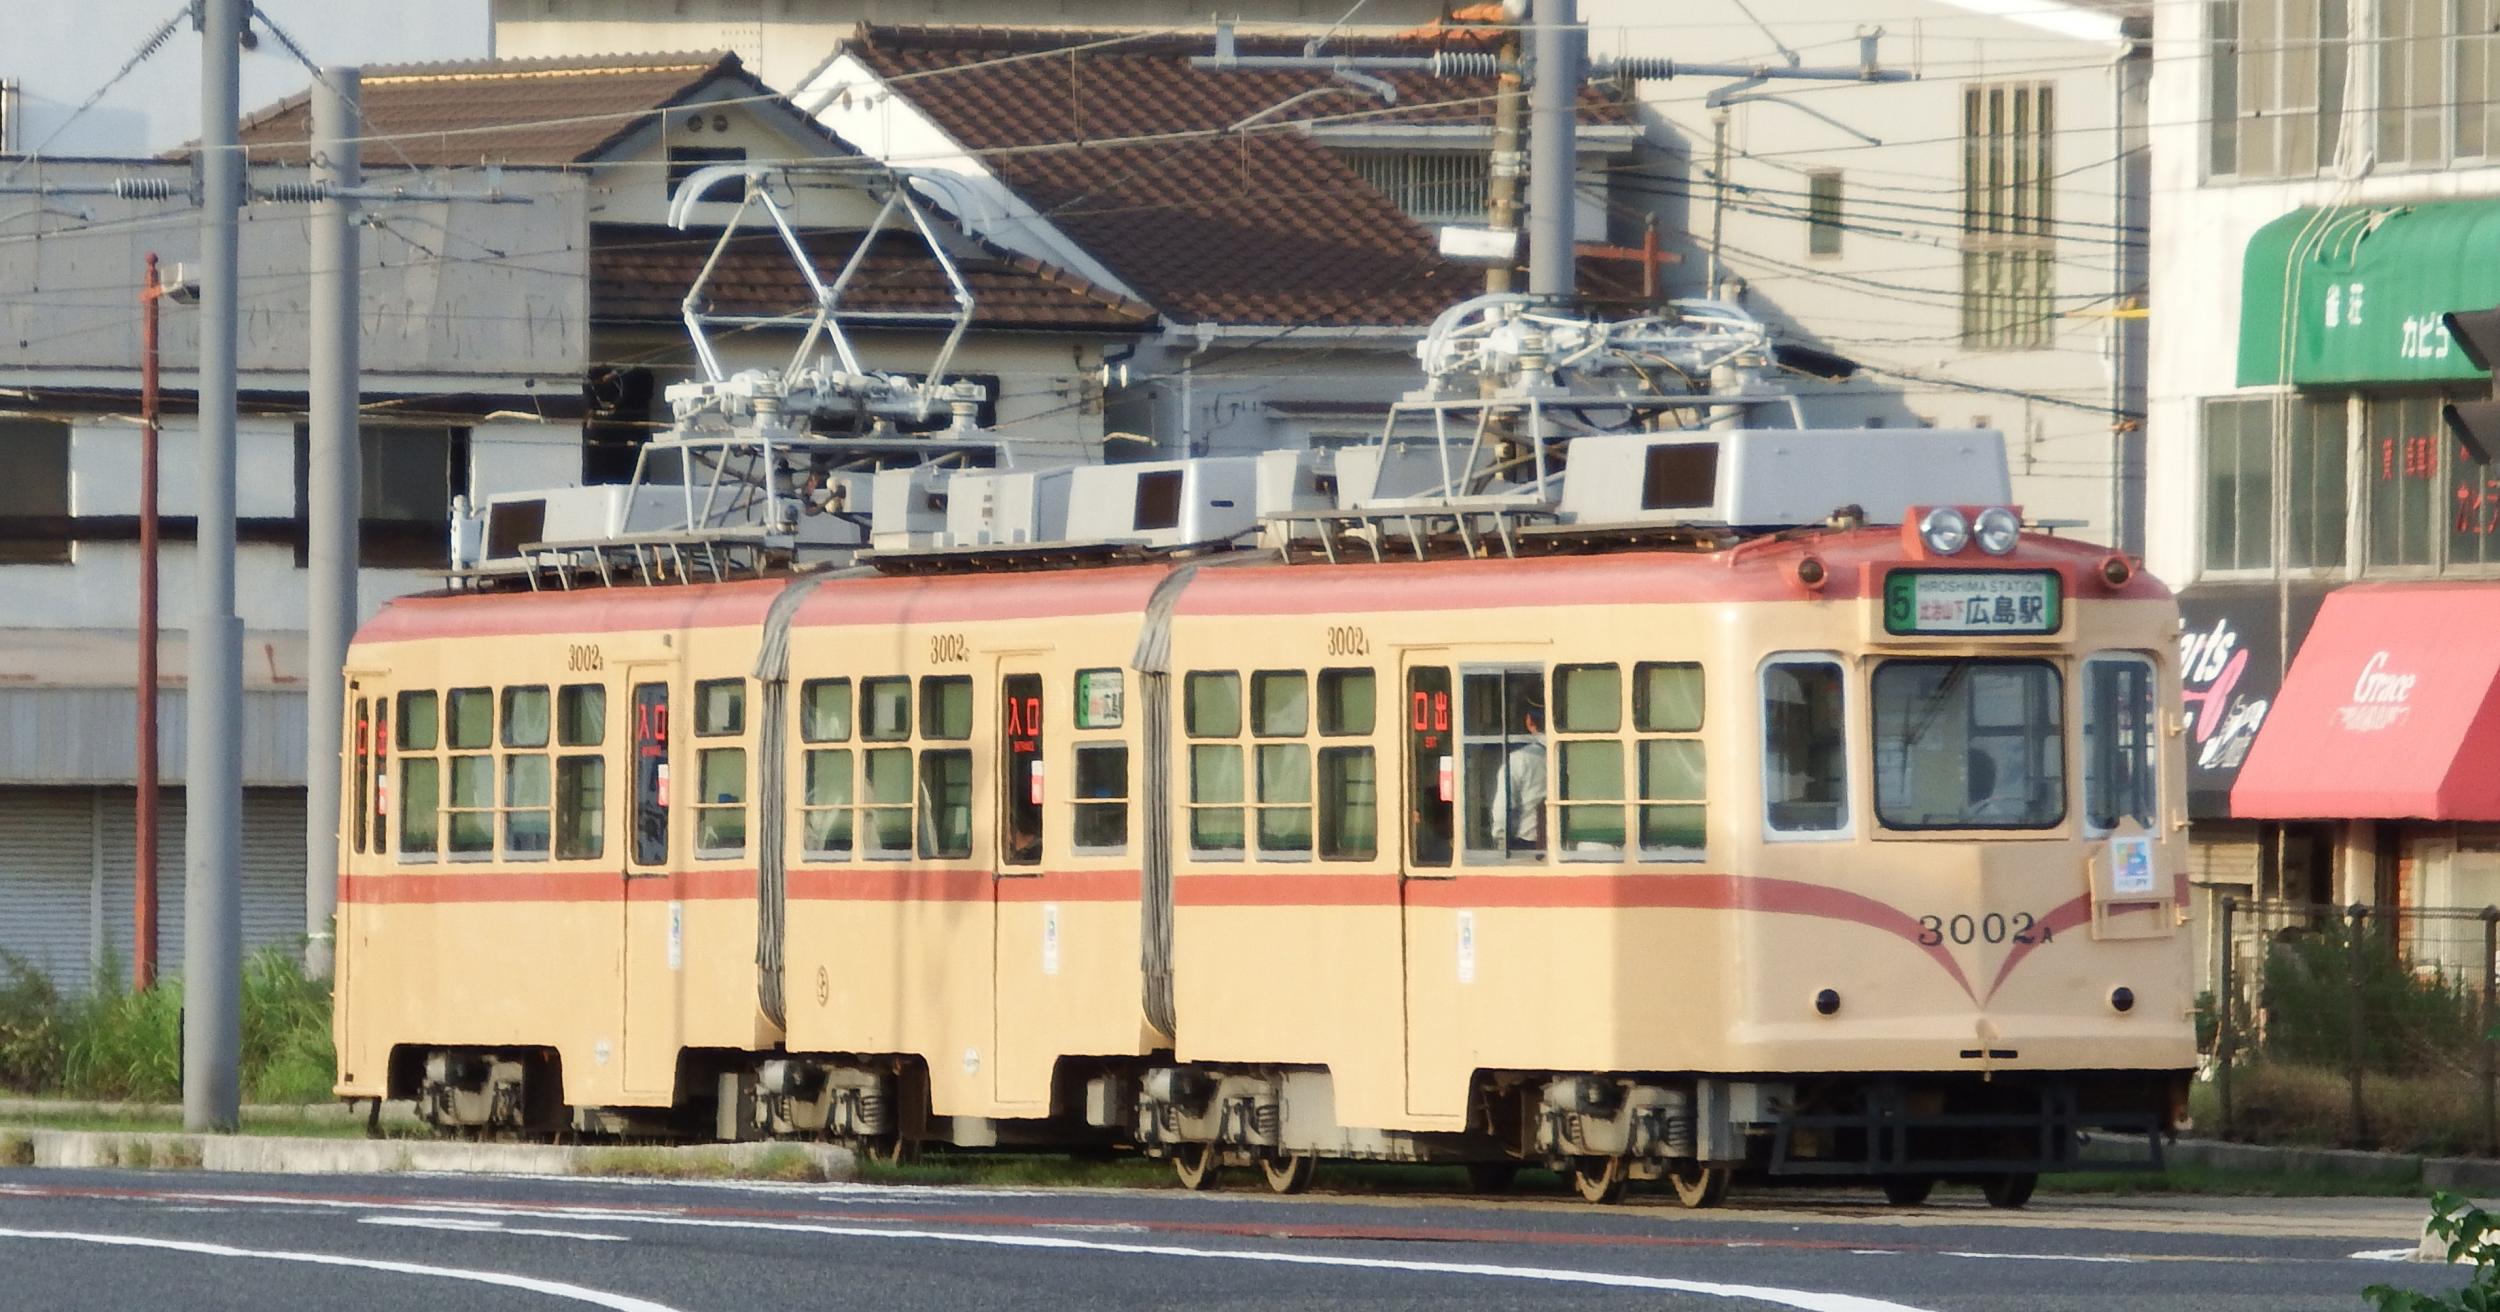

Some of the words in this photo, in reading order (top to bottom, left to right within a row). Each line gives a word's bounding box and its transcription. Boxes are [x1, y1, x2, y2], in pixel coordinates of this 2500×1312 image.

[1918, 581, 1987, 593] HIROSHIMA
[1990, 580, 2043, 592] STATION
[1890, 586, 1911, 621] 5
[1965, 595, 2043, 625] 広島駅
